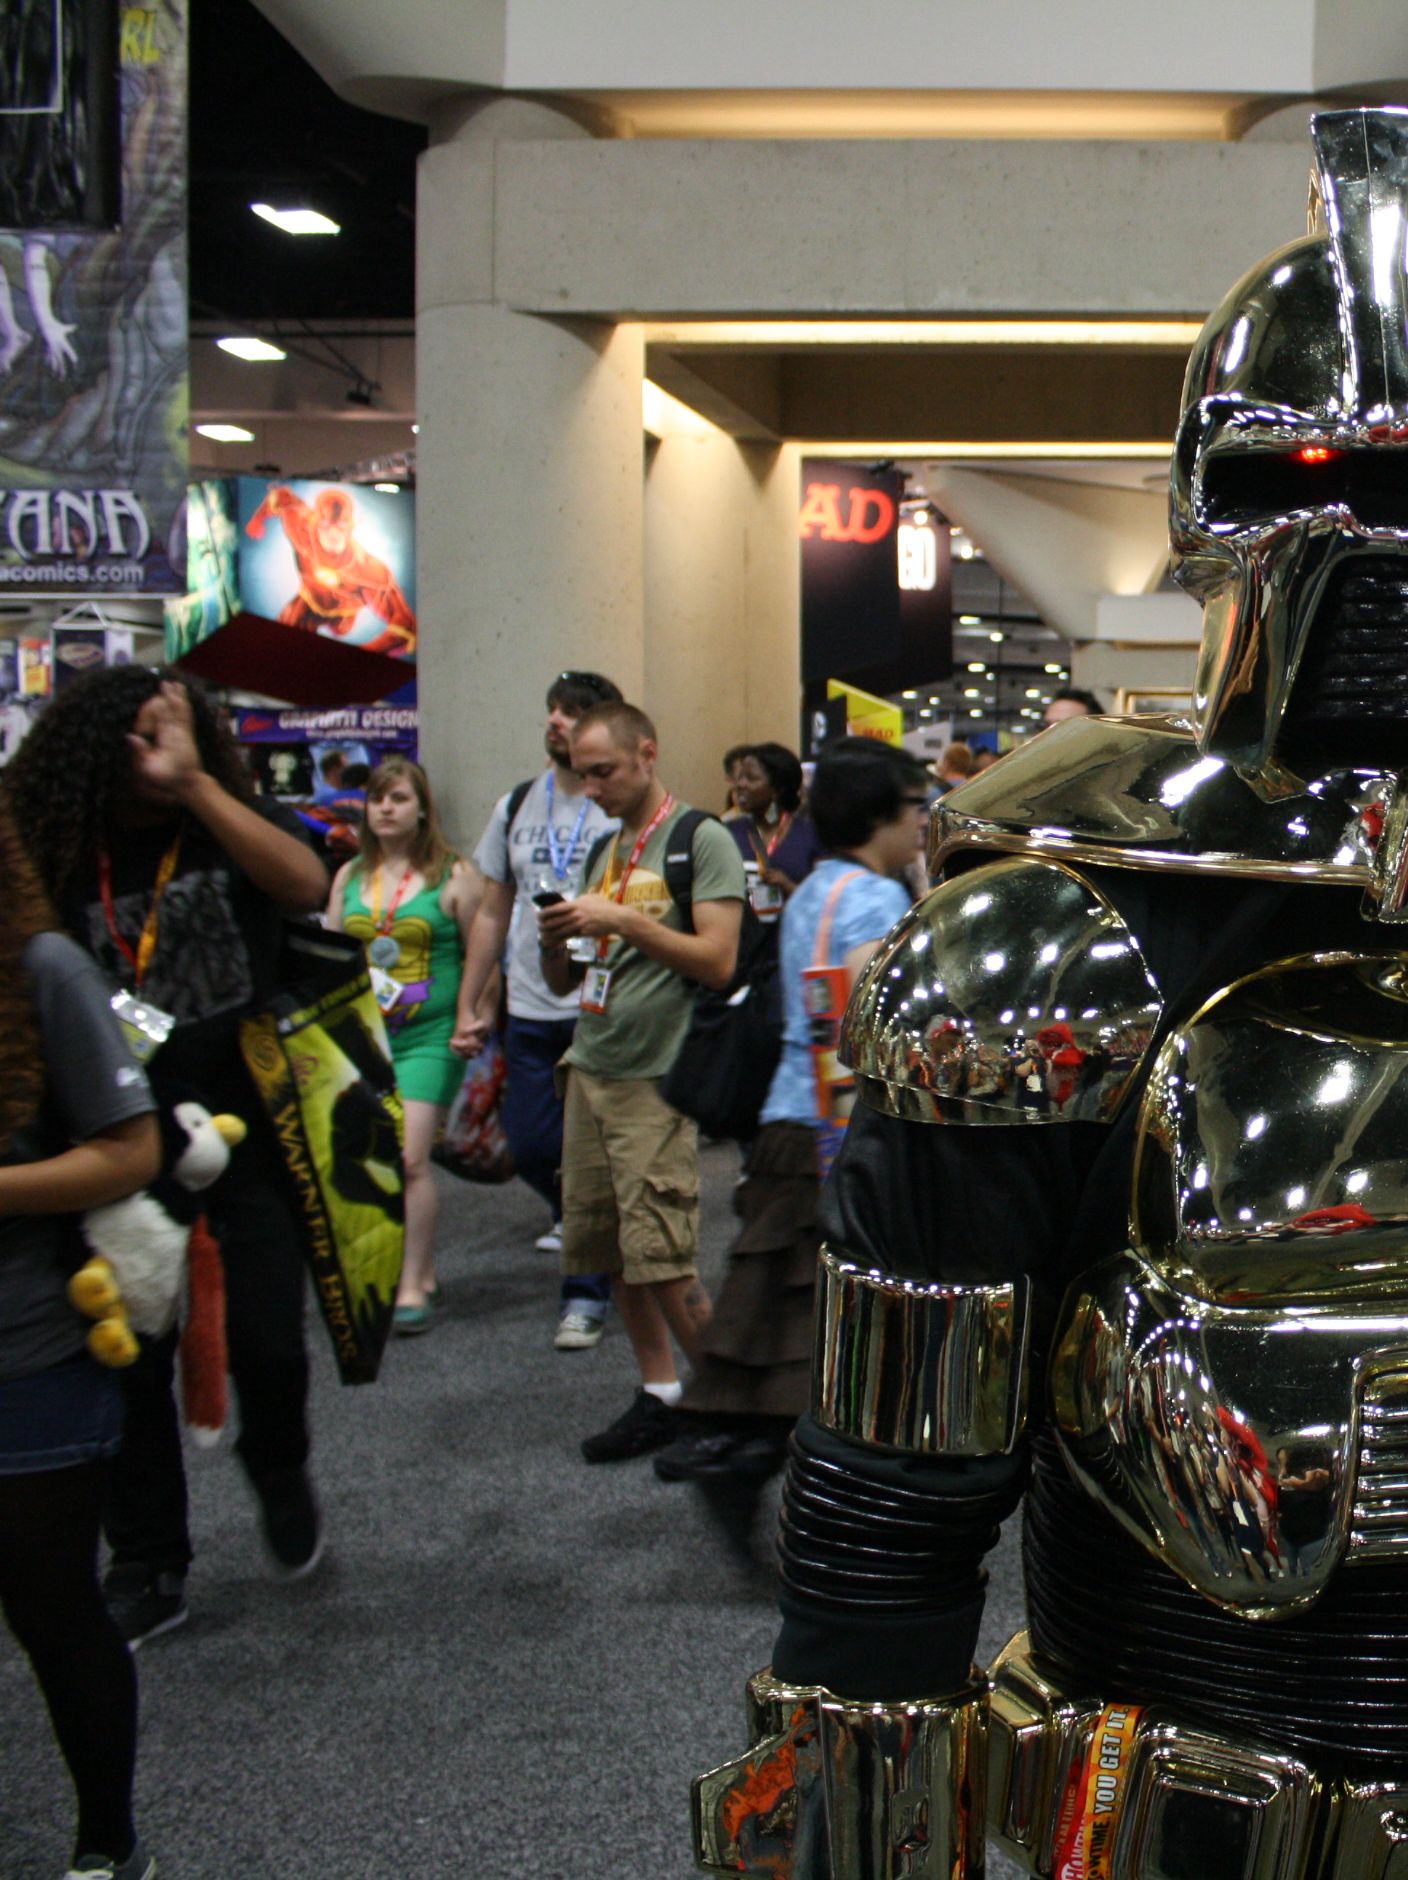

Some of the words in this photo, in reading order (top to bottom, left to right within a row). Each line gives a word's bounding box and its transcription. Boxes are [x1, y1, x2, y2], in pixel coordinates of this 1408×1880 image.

[0, 489, 149, 561] ANA
[1100, 1732, 1122, 1771] GET
[1095, 1774, 1119, 1815] YOU
